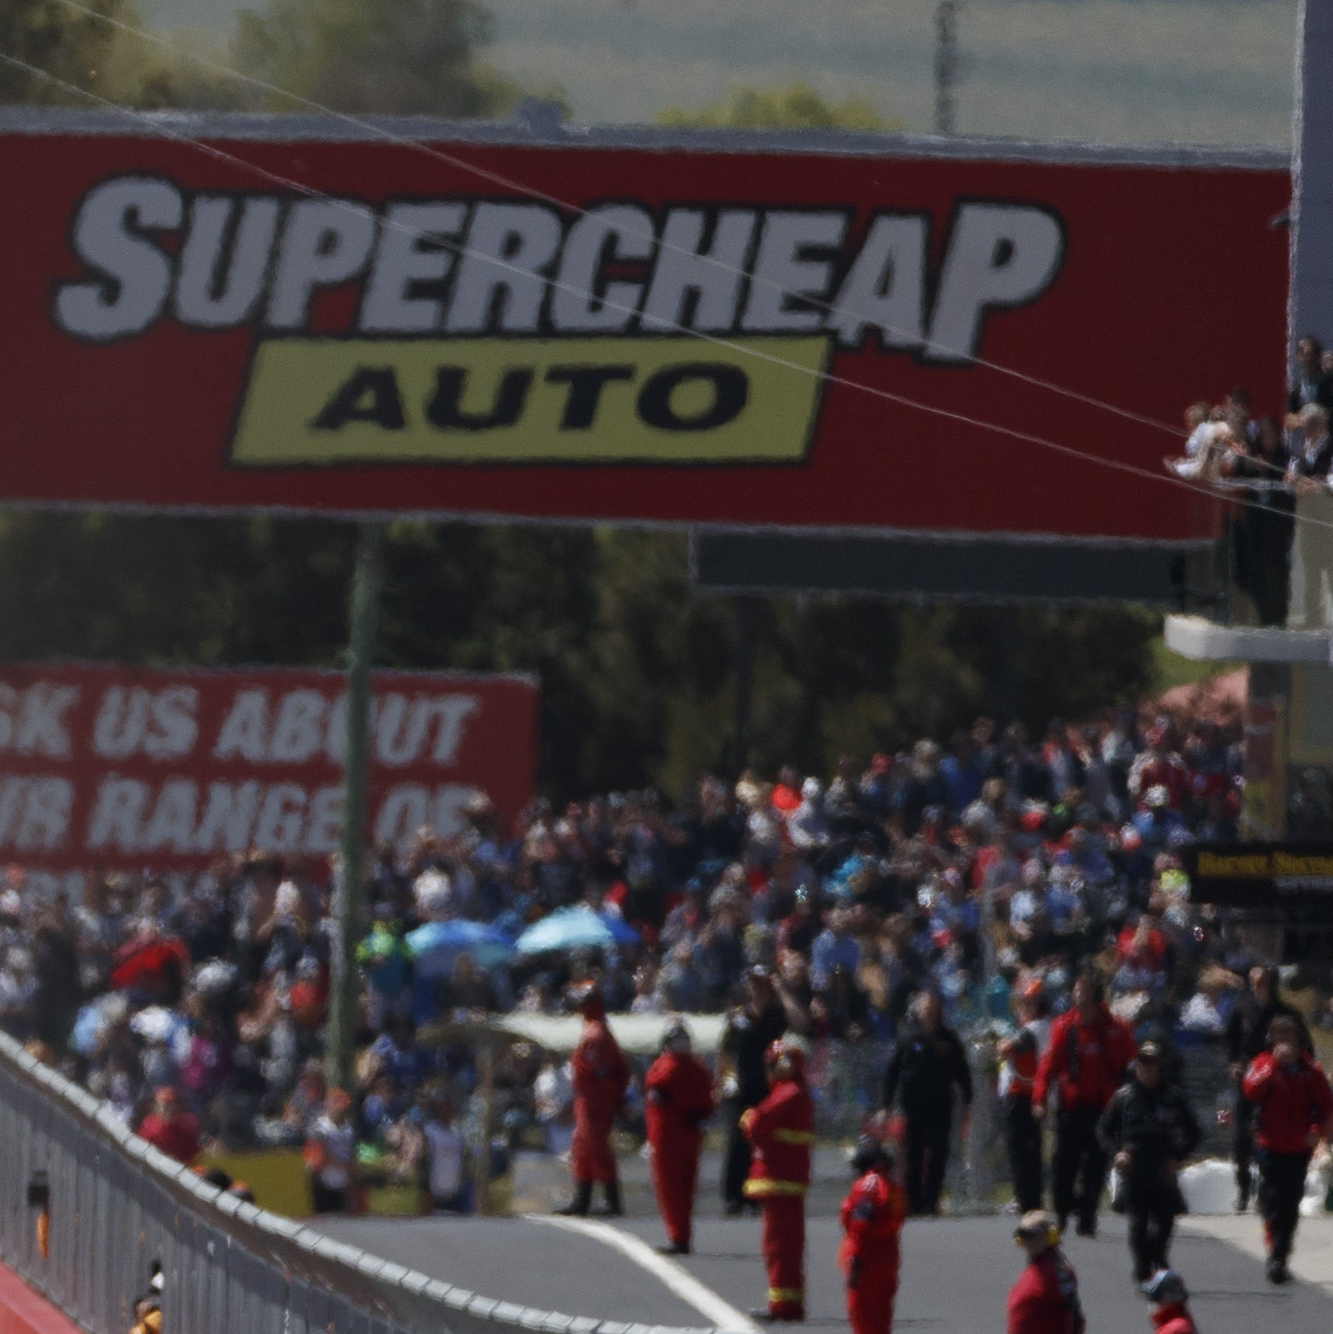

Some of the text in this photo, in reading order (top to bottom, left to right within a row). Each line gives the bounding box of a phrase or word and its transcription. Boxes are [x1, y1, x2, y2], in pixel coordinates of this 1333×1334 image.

[53, 177, 1062, 359] SUPERCHEAP
[310, 364, 748, 432] AUTO
[94, 686, 198, 758] US
[85, 774, 344, 855] RANGE
